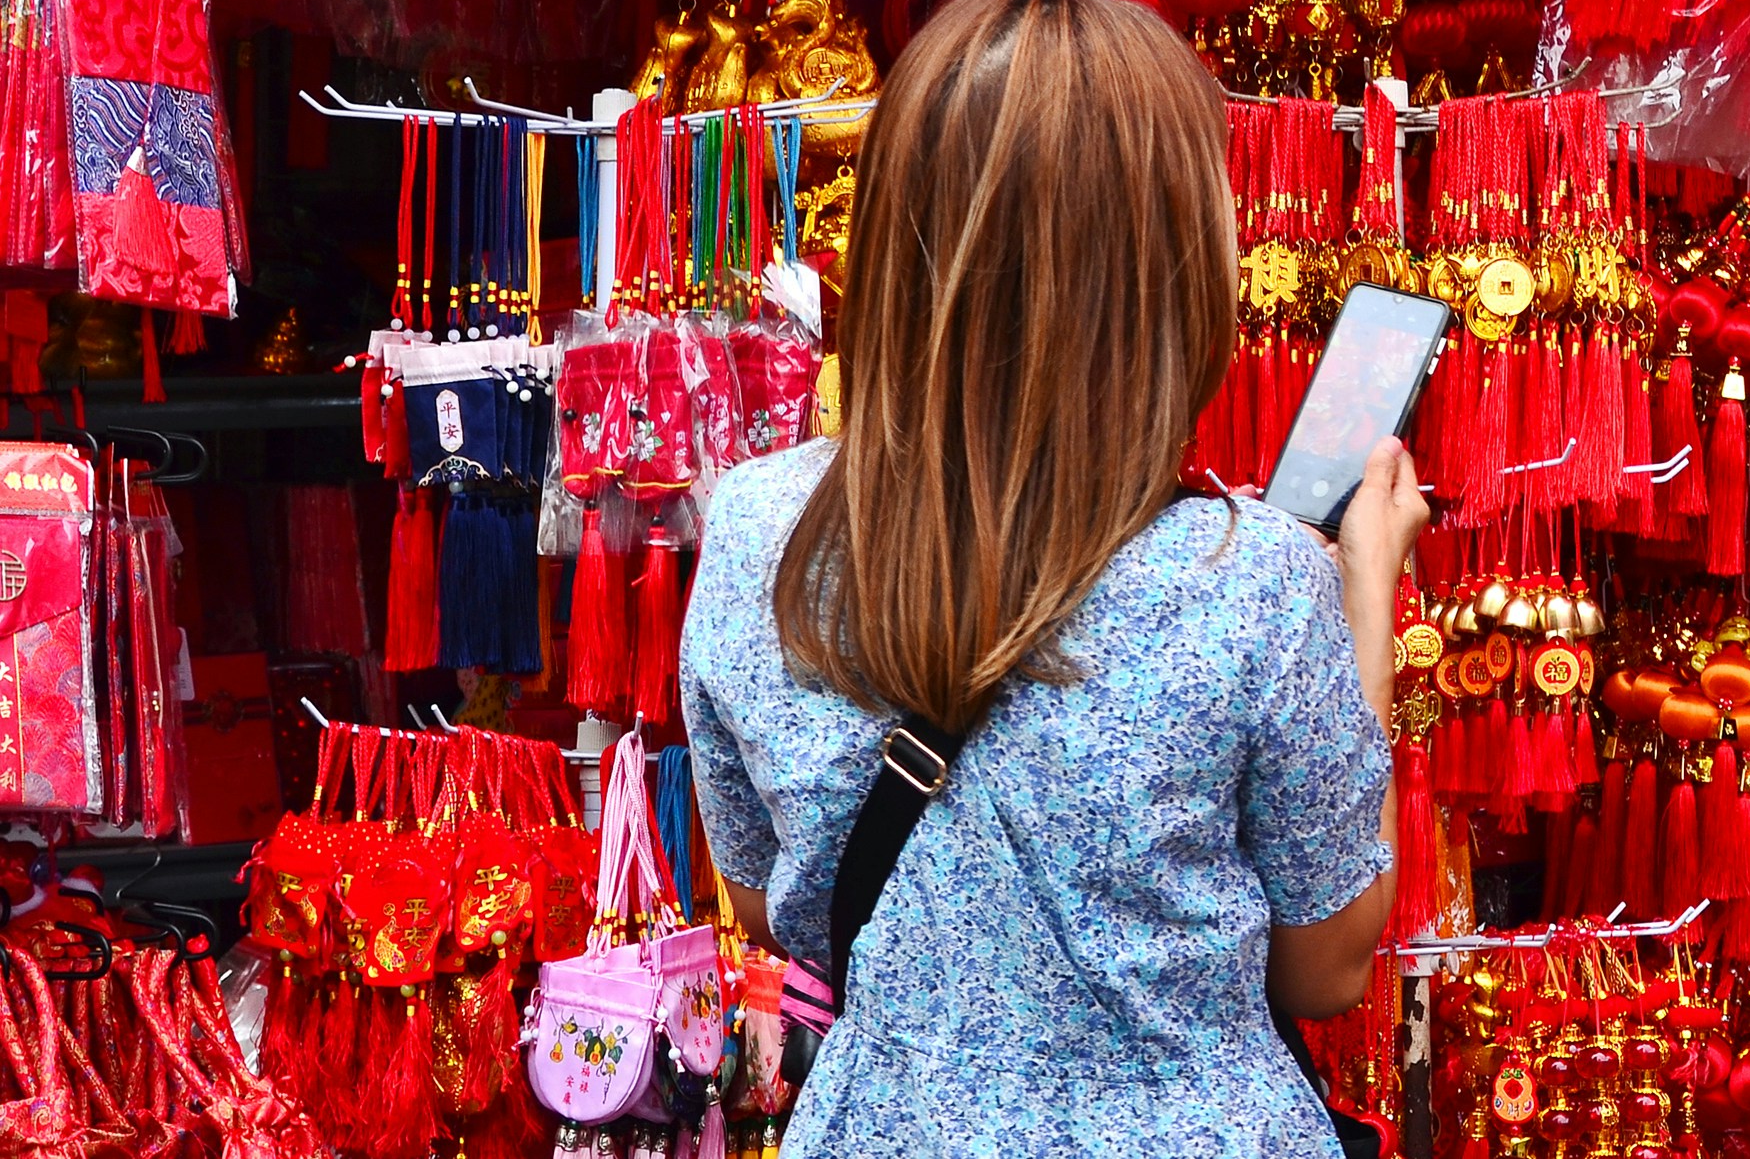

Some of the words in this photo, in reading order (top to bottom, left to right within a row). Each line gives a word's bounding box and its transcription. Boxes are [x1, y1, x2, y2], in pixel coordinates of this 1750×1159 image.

[439, 401, 459, 438] 平安
[475, 865, 511, 919] 平安
[549, 876, 577, 926] 平安
[402, 898, 431, 950] 平安
